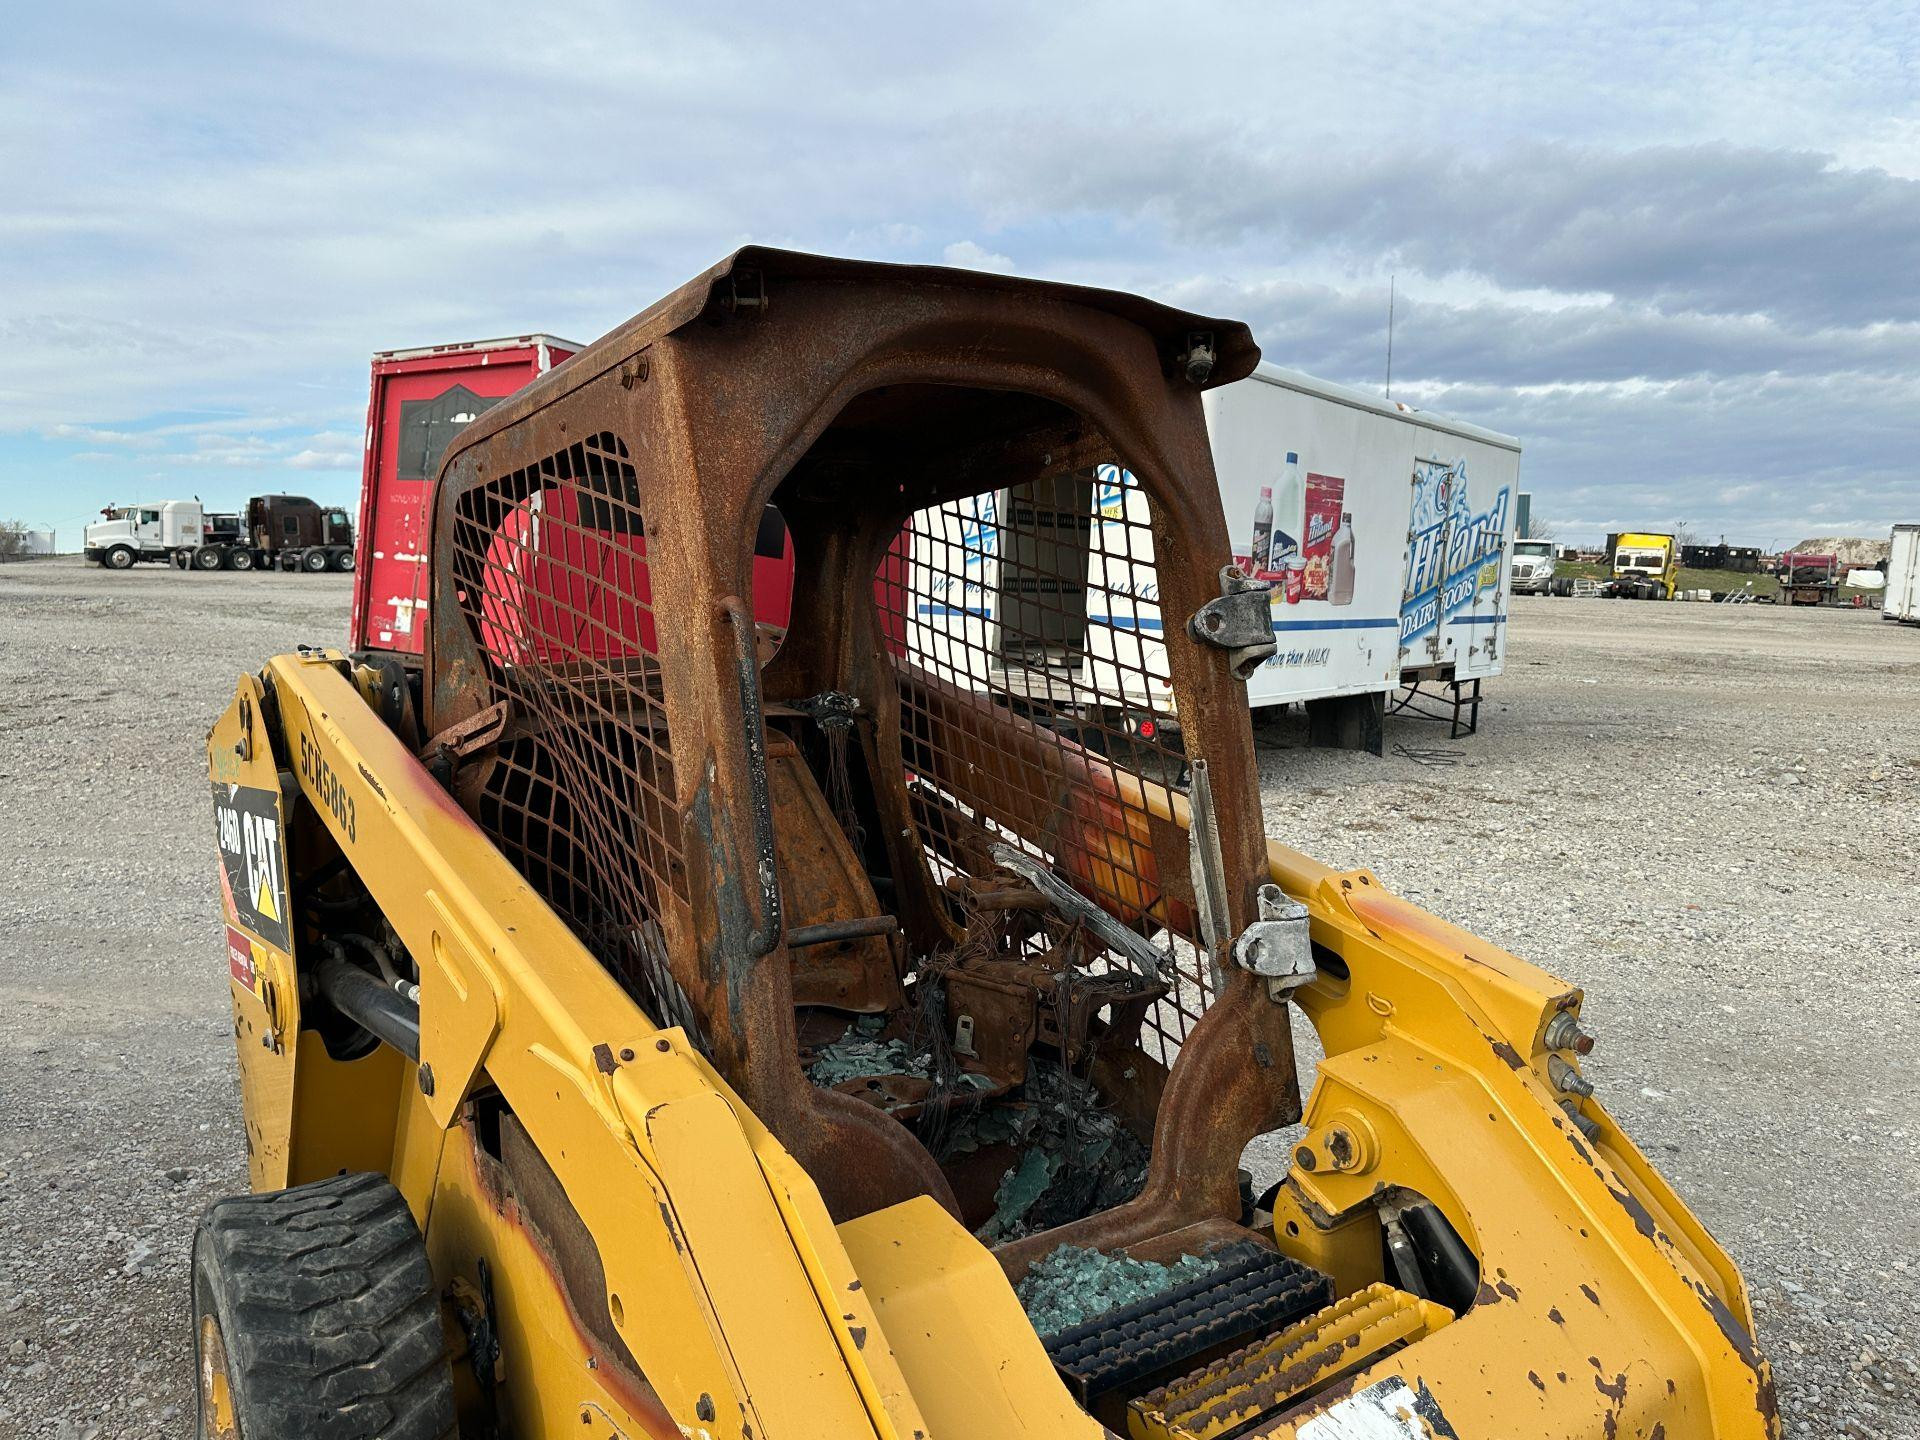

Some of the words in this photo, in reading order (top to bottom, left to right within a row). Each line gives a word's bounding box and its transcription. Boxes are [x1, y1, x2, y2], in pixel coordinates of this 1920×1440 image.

[1407, 490, 1508, 595] Hiland
[1401, 598, 1438, 640] DAIRY
[300, 731, 356, 844] 5CR5863
[243, 810, 281, 923] CAT
